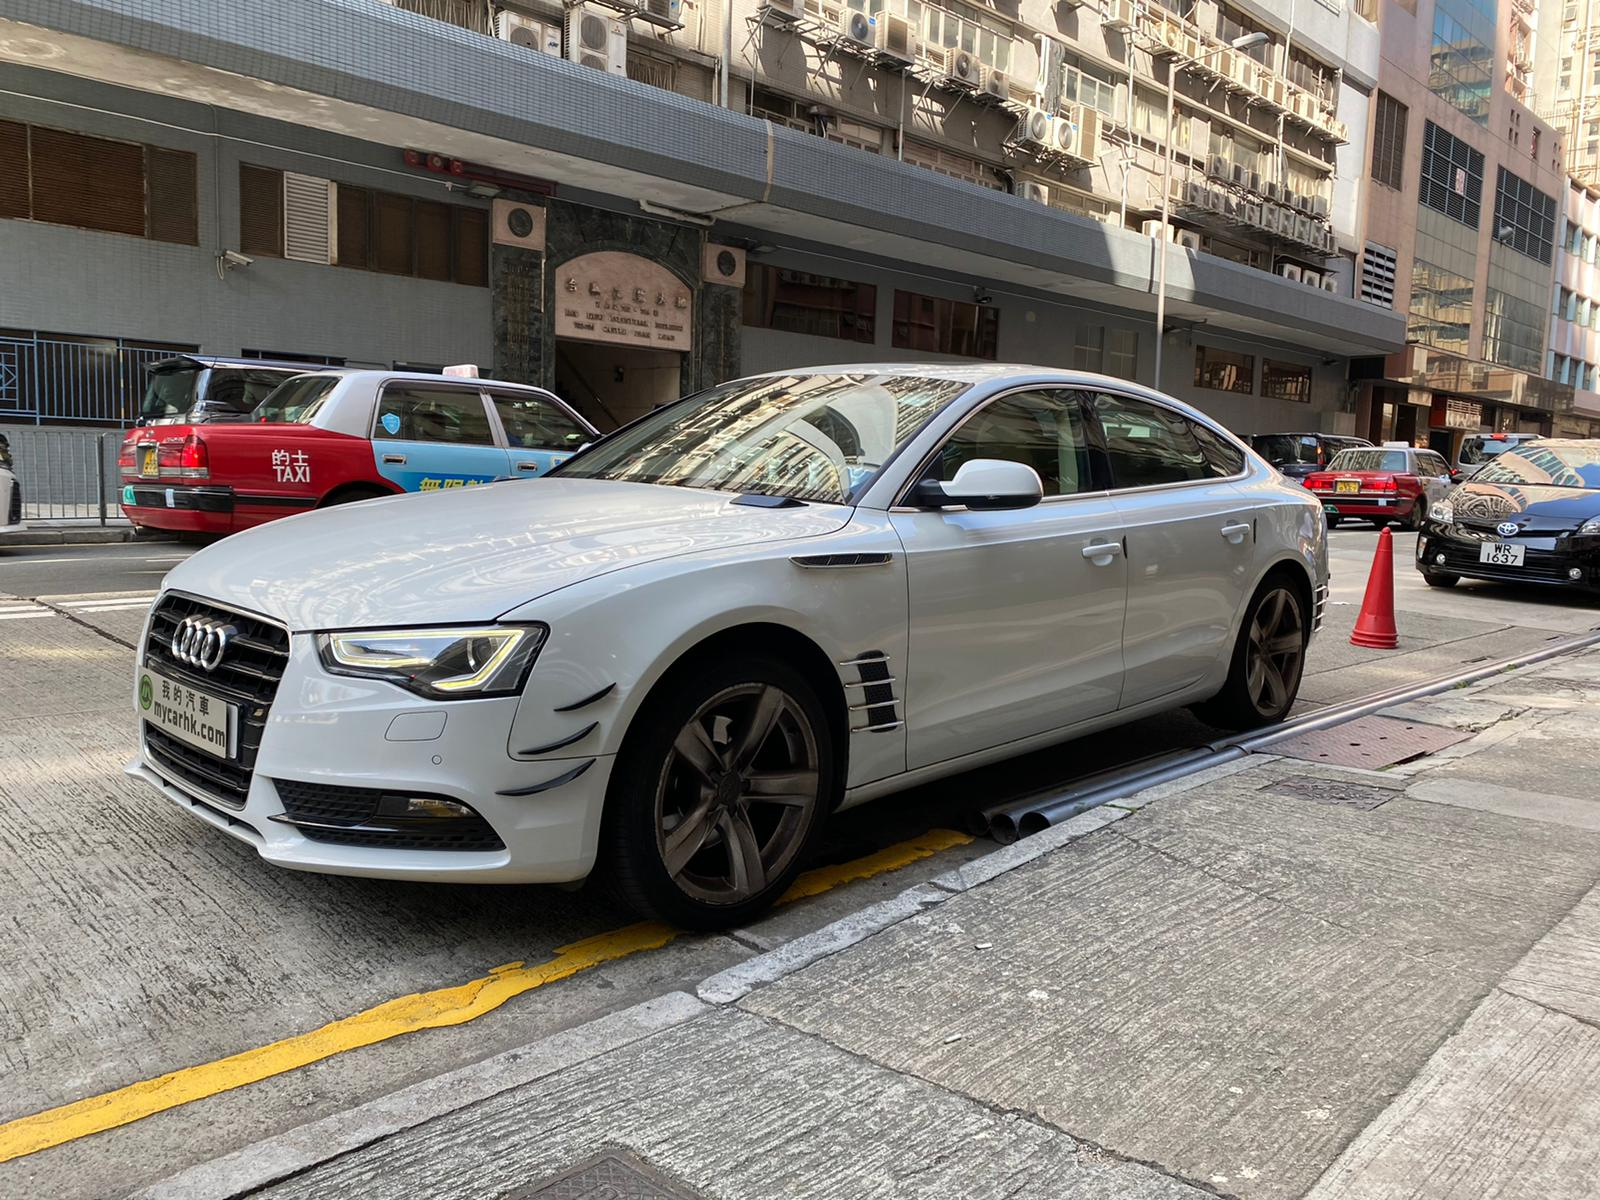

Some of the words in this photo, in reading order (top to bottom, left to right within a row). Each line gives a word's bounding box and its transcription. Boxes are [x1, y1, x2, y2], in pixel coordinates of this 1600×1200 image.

[271, 449, 309, 466] 的士
[272, 465, 311, 483] TAXI
[1494, 543, 1512, 554] WR
[1486, 552, 1519, 565] 1637
[161, 679, 209, 716] 我的汽車
[153, 700, 226, 748] mycarhk.com
